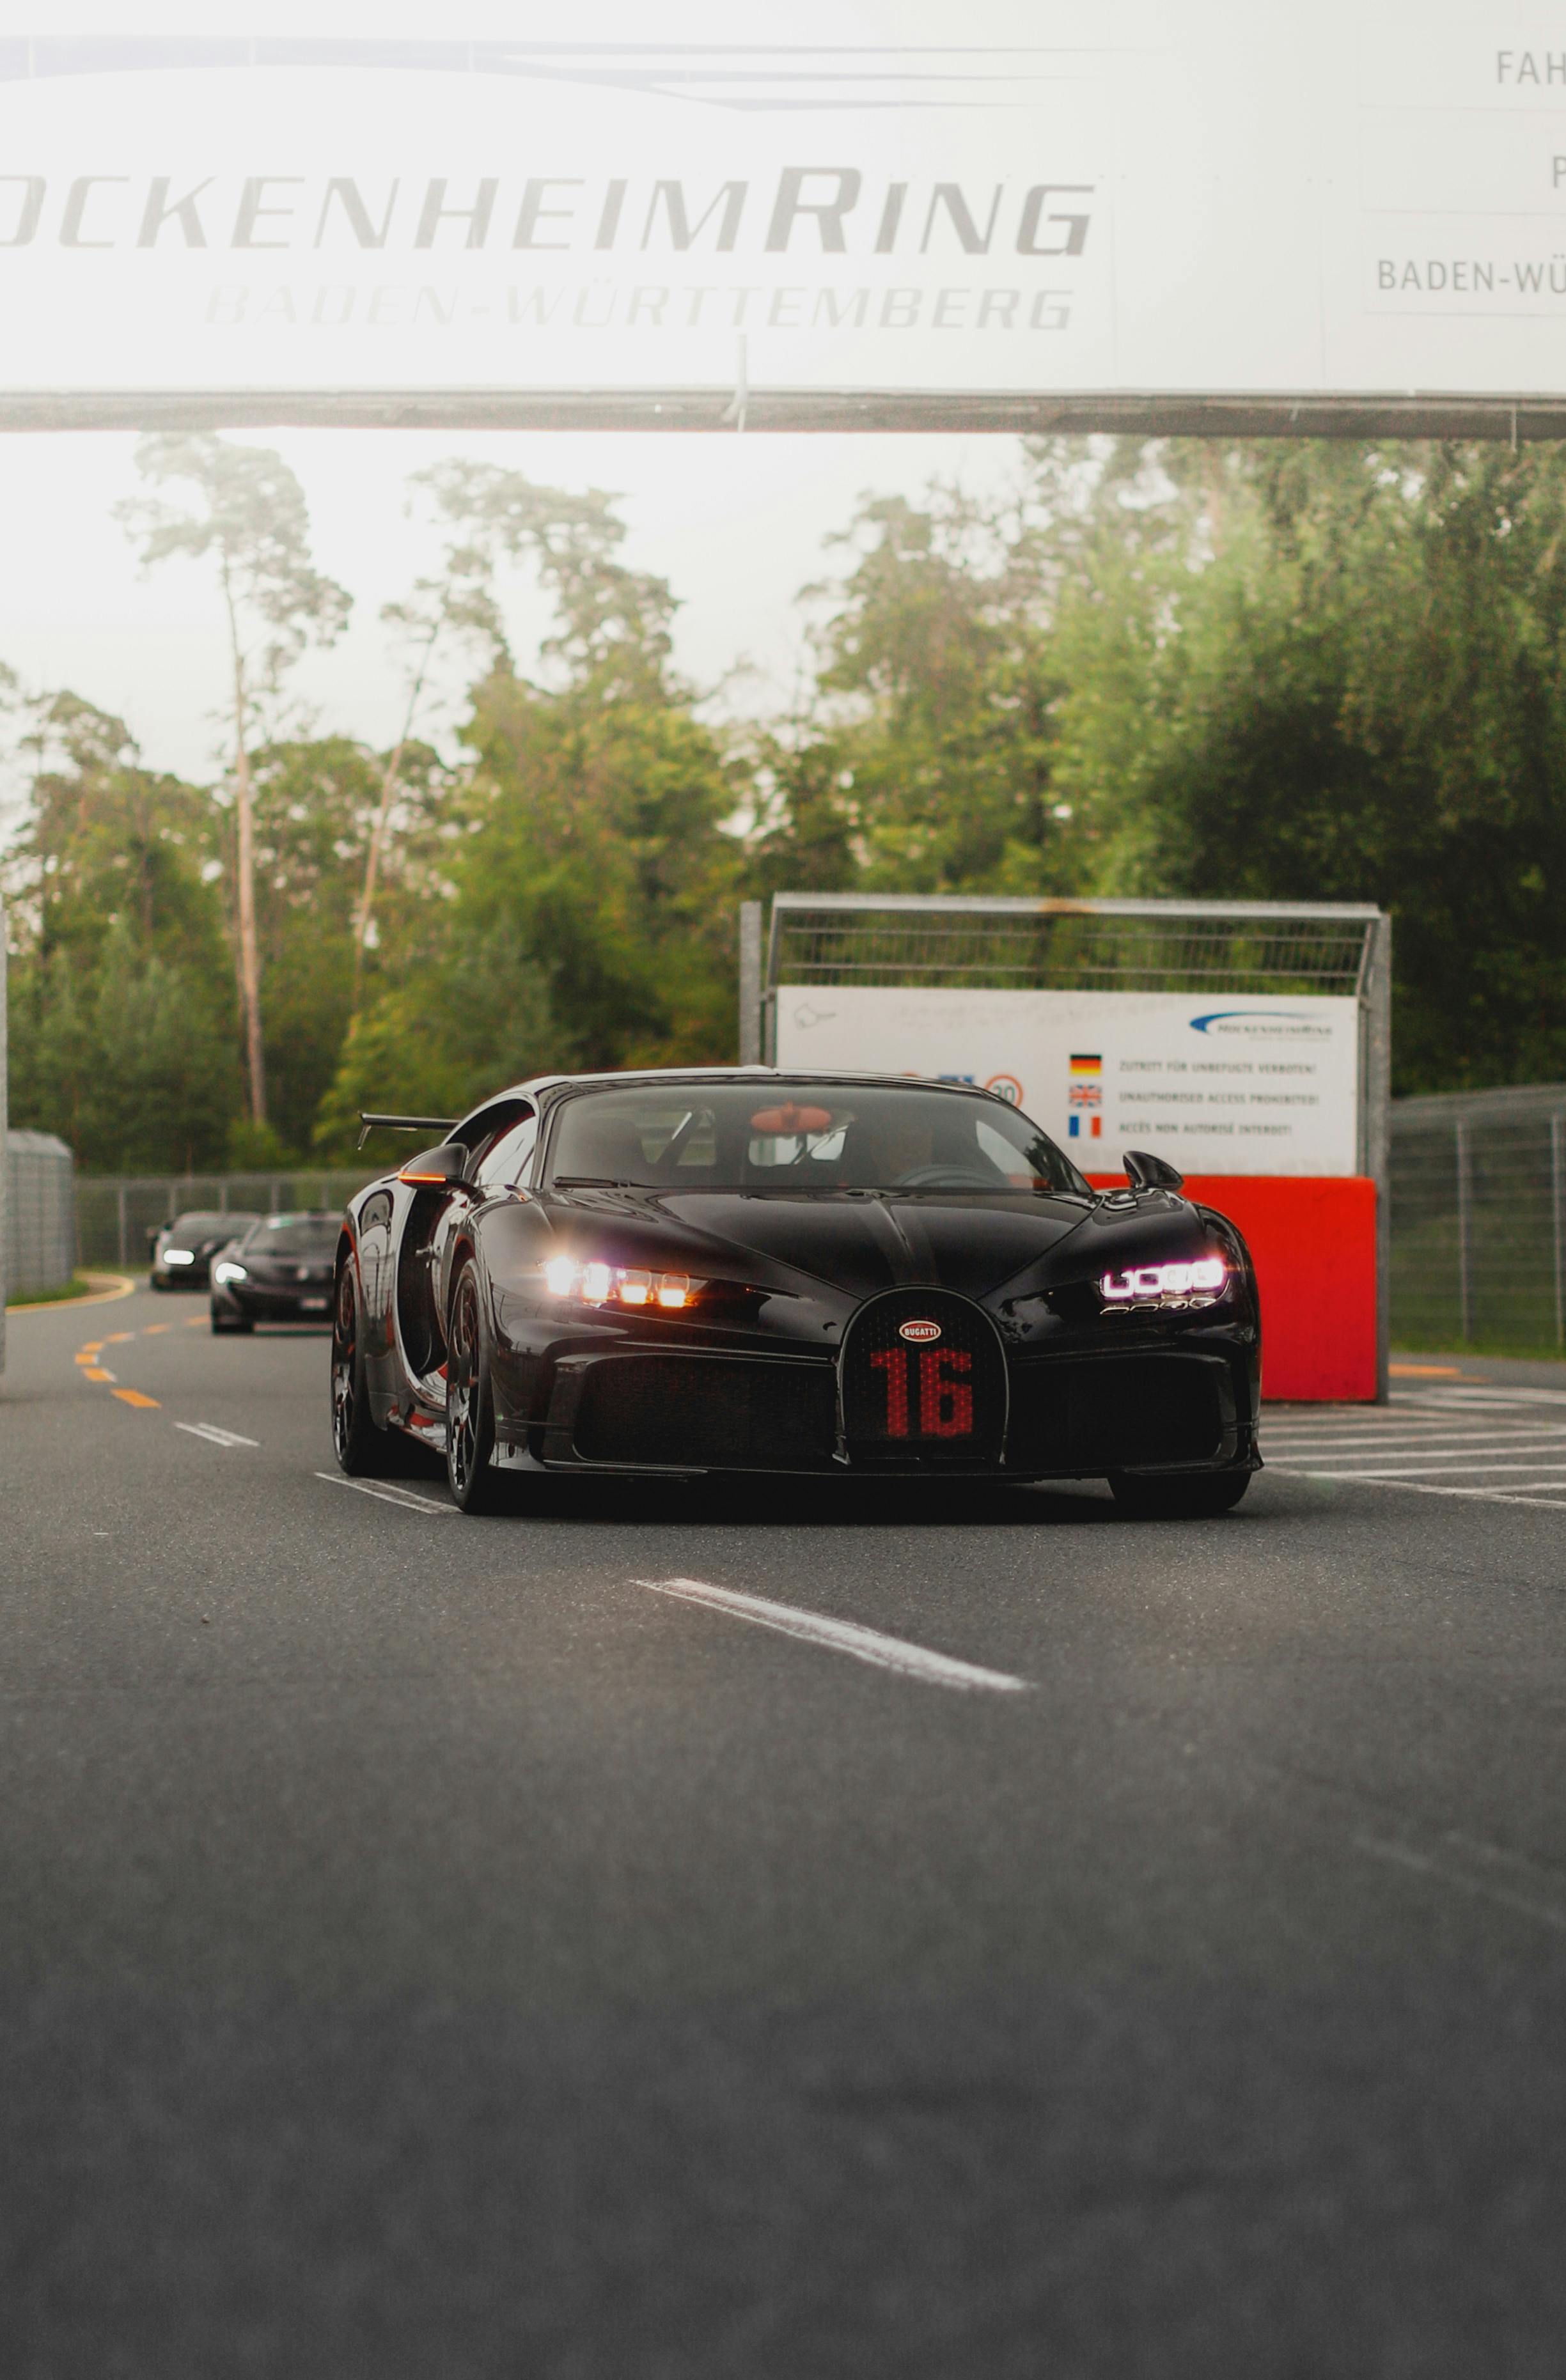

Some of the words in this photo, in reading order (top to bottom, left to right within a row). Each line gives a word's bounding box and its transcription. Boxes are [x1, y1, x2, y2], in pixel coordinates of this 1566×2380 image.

[204, 277, 1075, 329] BADEN-WÜRTTEMBERG
[1120, 1061, 1162, 1072] ZUTRITT
[1167, 1059, 1187, 1072] FÜR
[1192, 1062, 1253, 1073] UNBEFUGTE
[1120, 1092, 1203, 1103] UNAUTHORISED
[1208, 1093, 1246, 1104] ACCESS
[1155, 1123, 1178, 1133] NON
[904, 1327, 936, 1336] BUGATTI
[870, 1348, 973, 1436] 16
